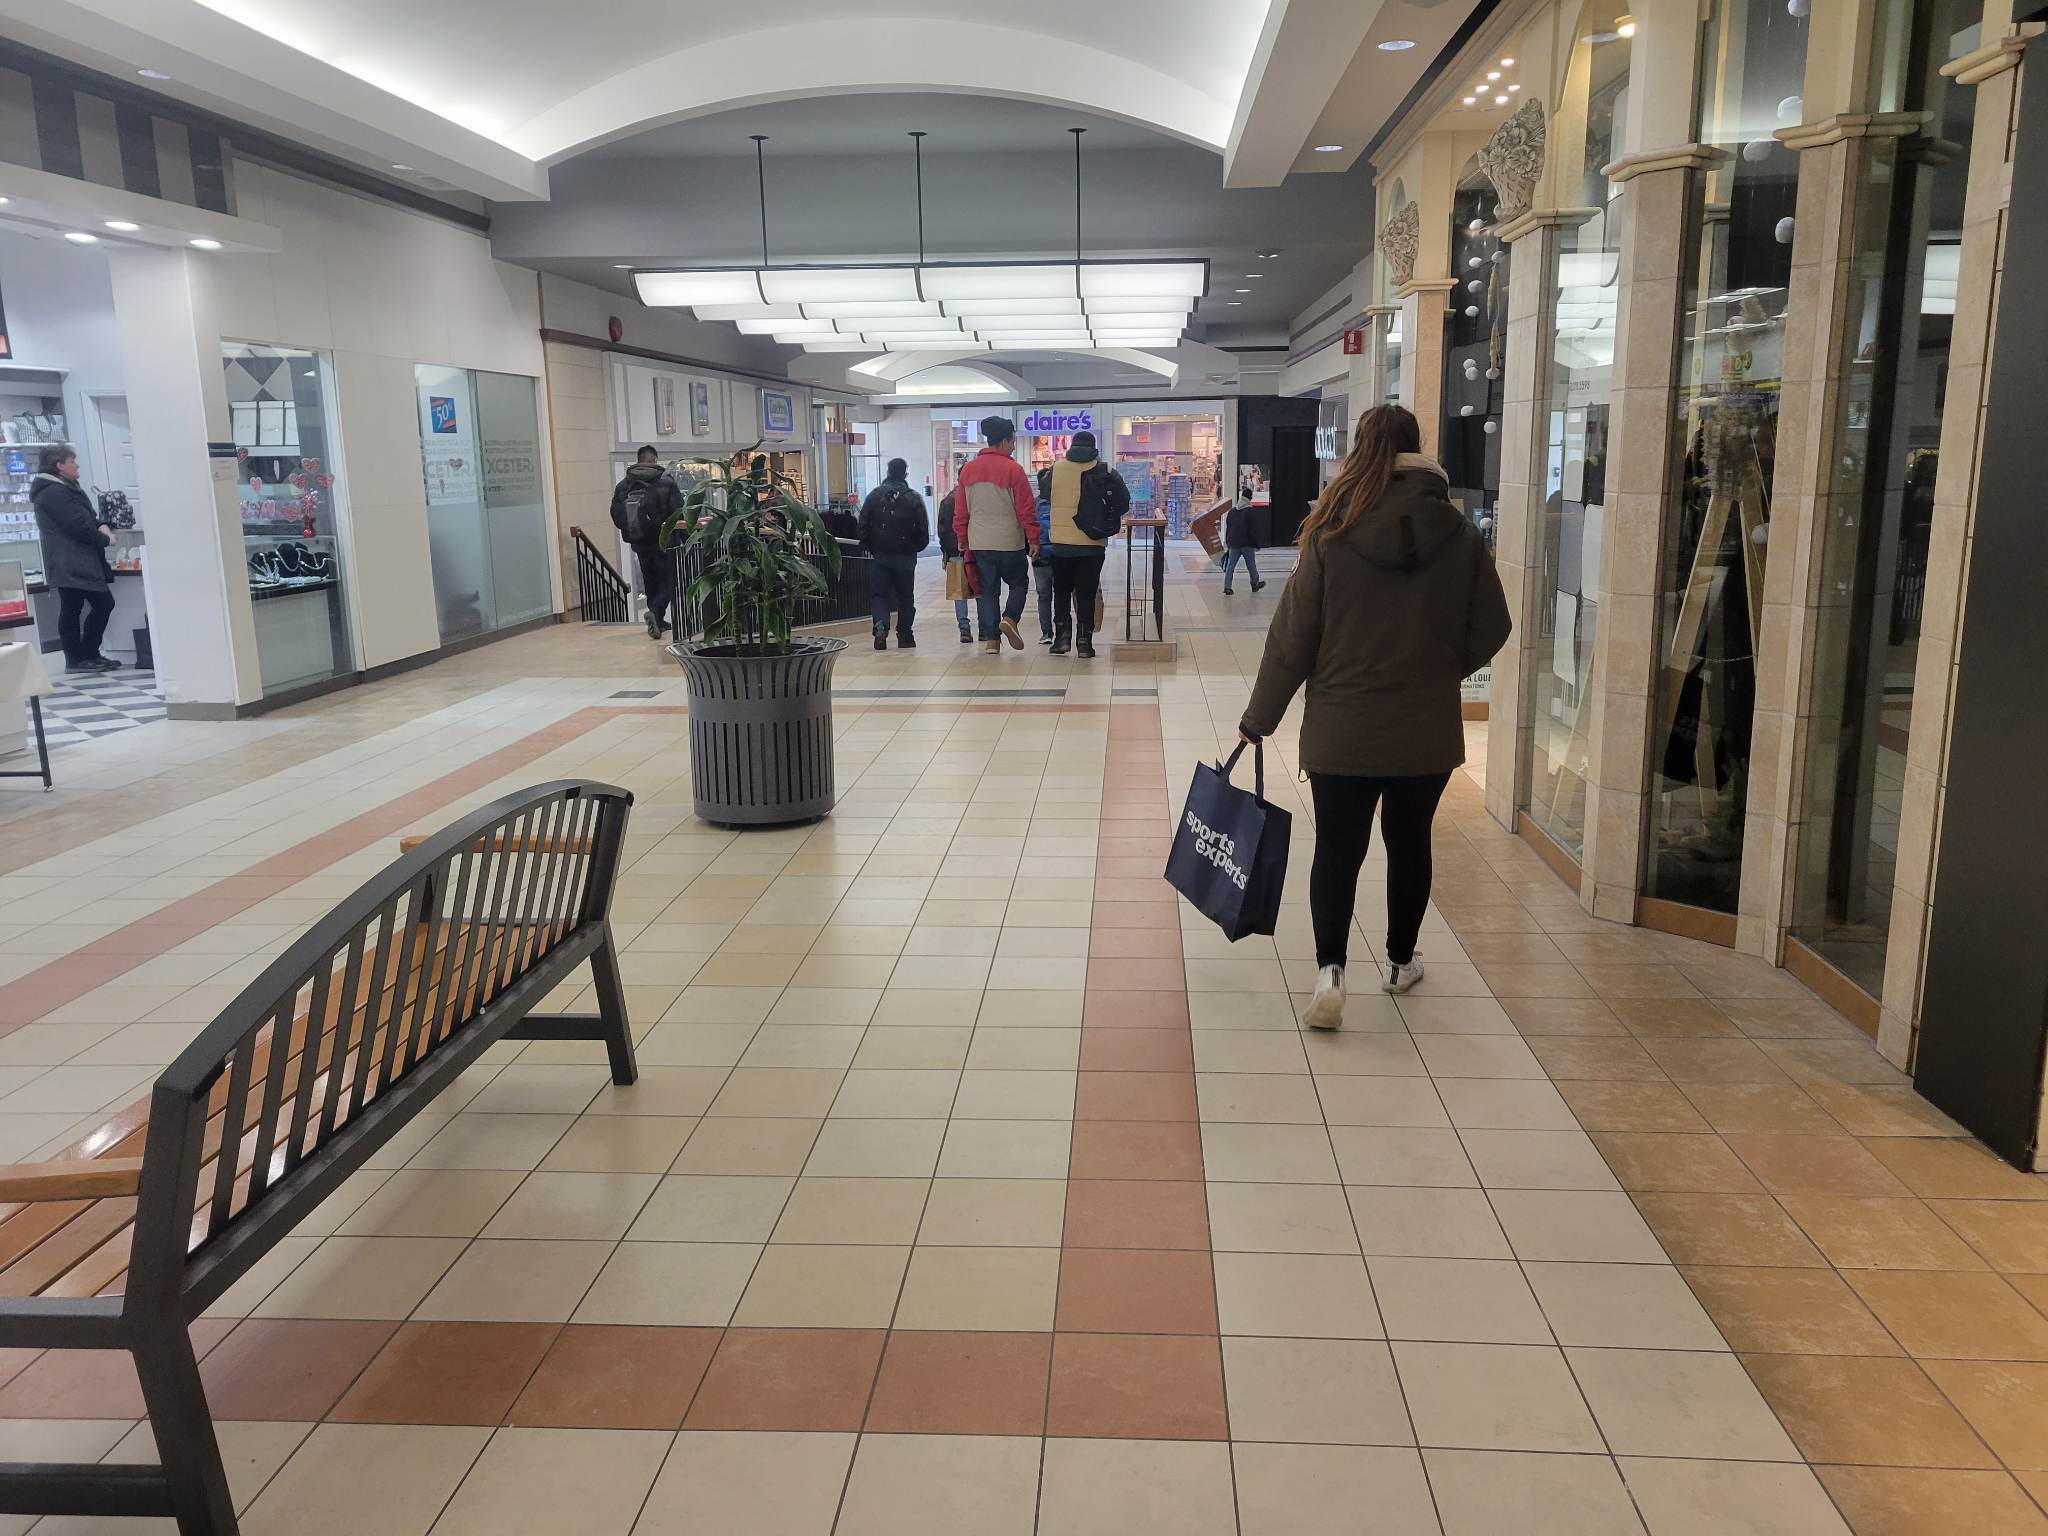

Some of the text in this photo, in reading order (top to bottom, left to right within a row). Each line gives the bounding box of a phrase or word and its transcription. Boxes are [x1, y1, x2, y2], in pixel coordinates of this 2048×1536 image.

[1024, 410, 1092, 431] claire's
[1186, 810, 1235, 856] sports
[1195, 838, 1247, 890] experts
